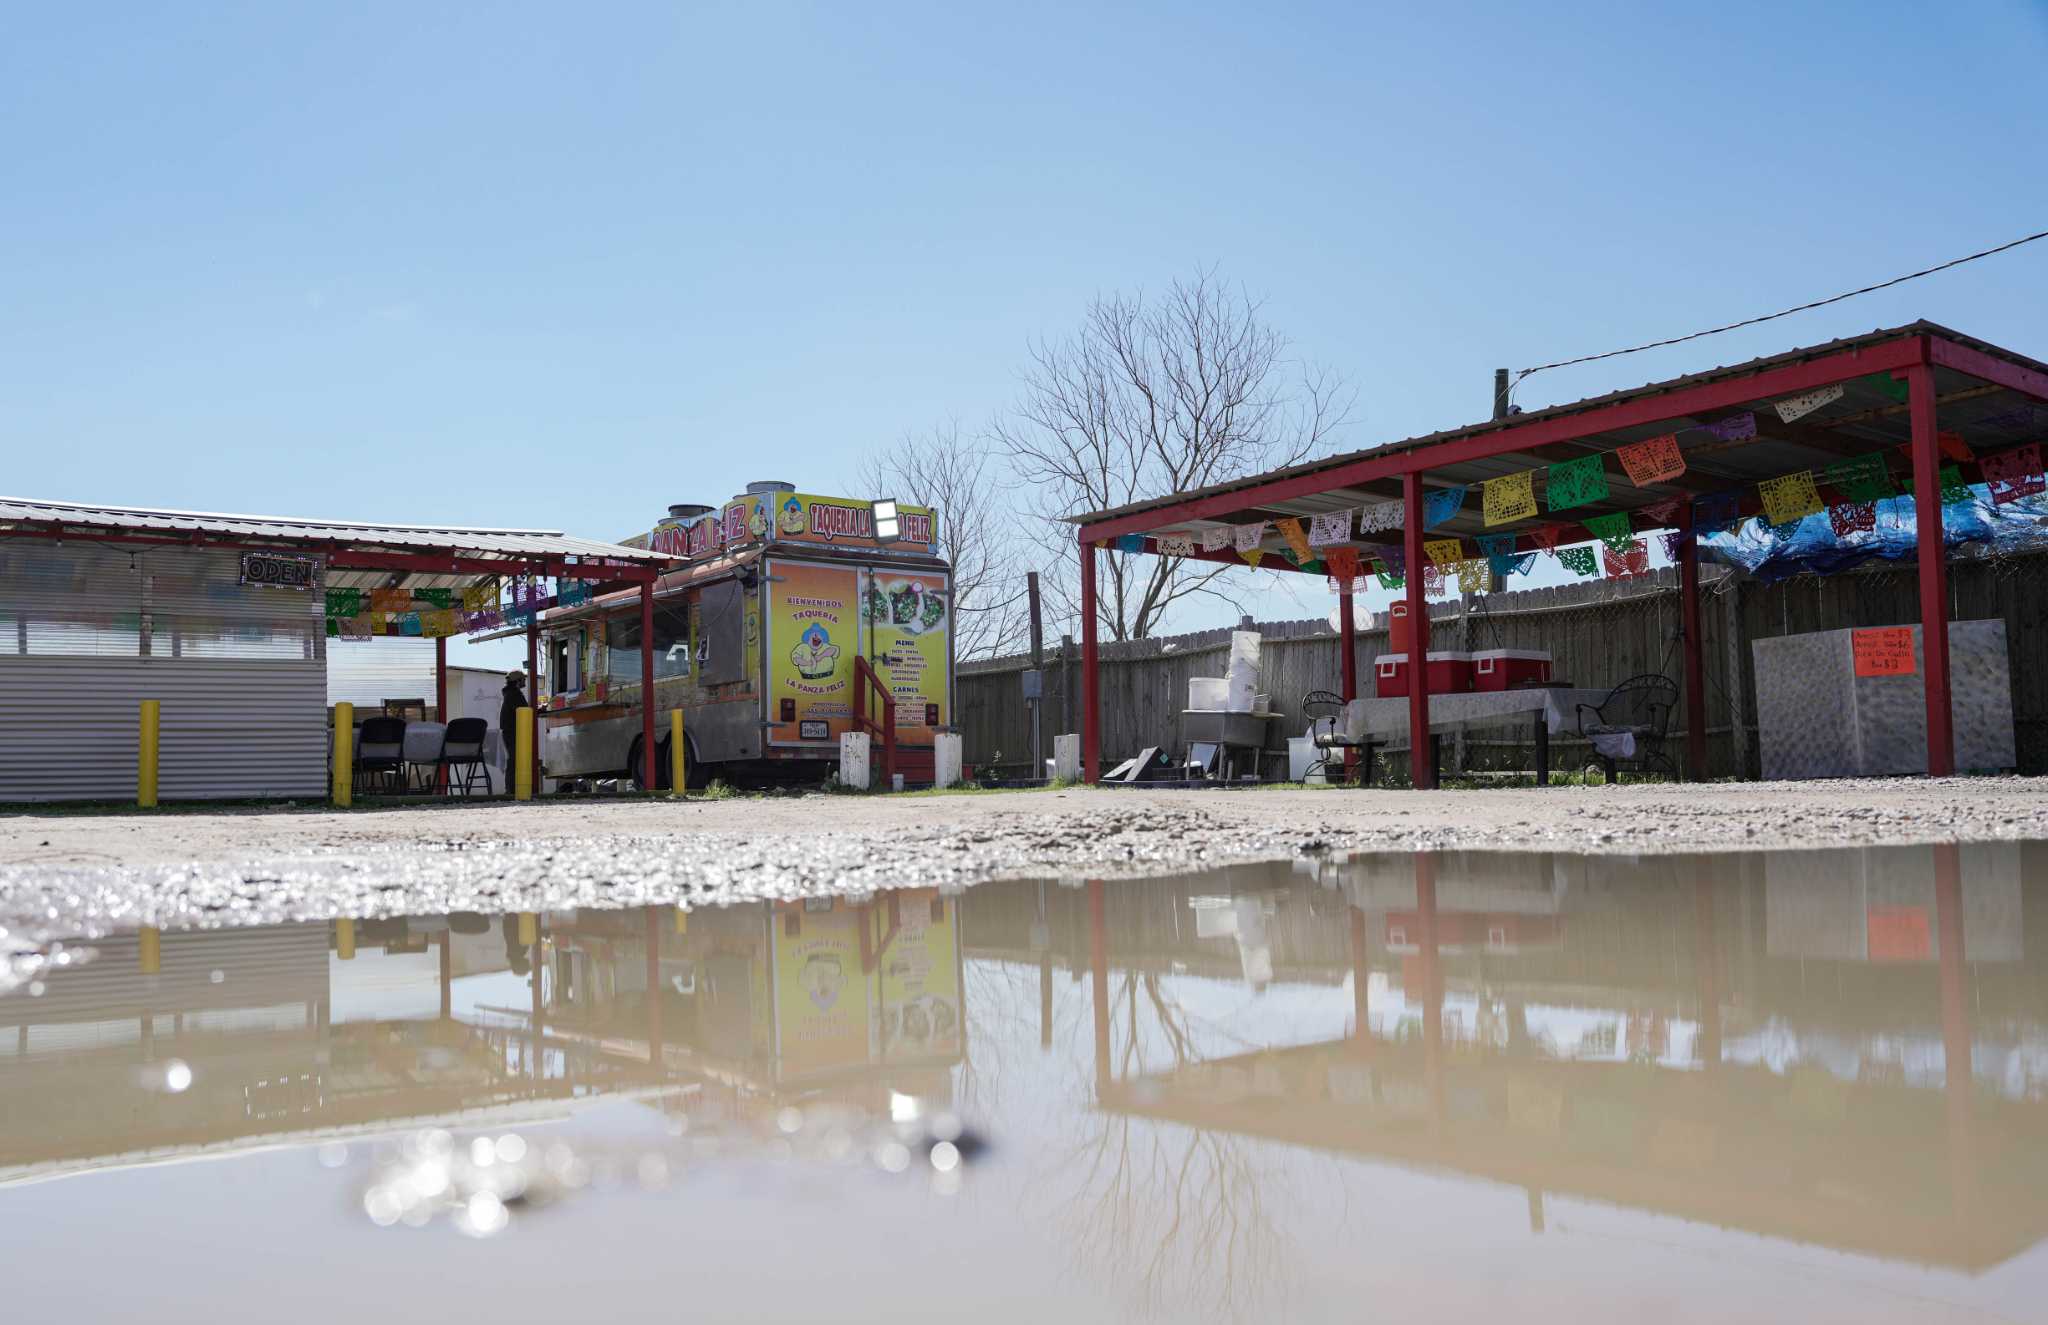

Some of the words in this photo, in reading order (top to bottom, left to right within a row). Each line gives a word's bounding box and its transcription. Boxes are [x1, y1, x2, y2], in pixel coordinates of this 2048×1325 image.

[810, 504, 859, 540] TAQUERIA
[858, 509, 873, 538] LA
[905, 514, 932, 543] FELIZ
[247, 559, 311, 584] OPEN
[787, 597, 842, 608] BIENVENIDOS
[792, 609, 838, 624] TAQUERIA
[785, 678, 797, 688] LA
[798, 682, 825, 694] PANZA
[826, 679, 846, 692] FELIZ
[892, 686, 919, 694] CARNES
